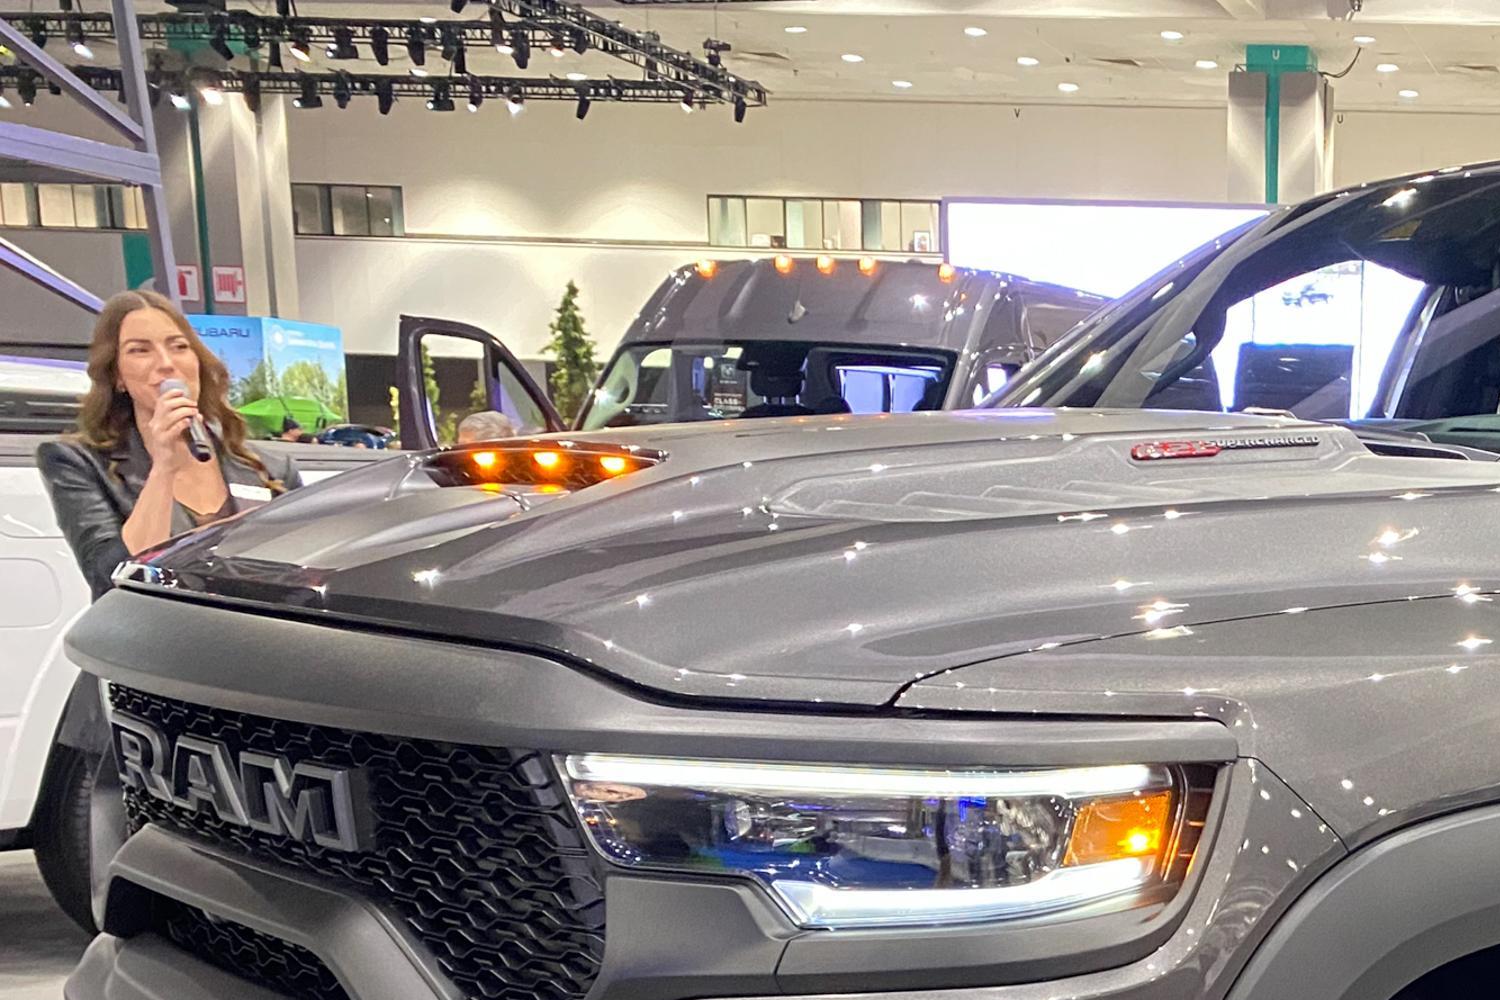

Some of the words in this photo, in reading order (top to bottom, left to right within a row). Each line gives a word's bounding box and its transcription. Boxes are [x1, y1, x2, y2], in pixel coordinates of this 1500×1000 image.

[1272, 50, 1280, 60] U
[1014, 108, 1020, 118] V
[1336, 114, 1344, 124] U
[196, 326, 250, 338] UBARU
[110, 708, 366, 852] RAM
